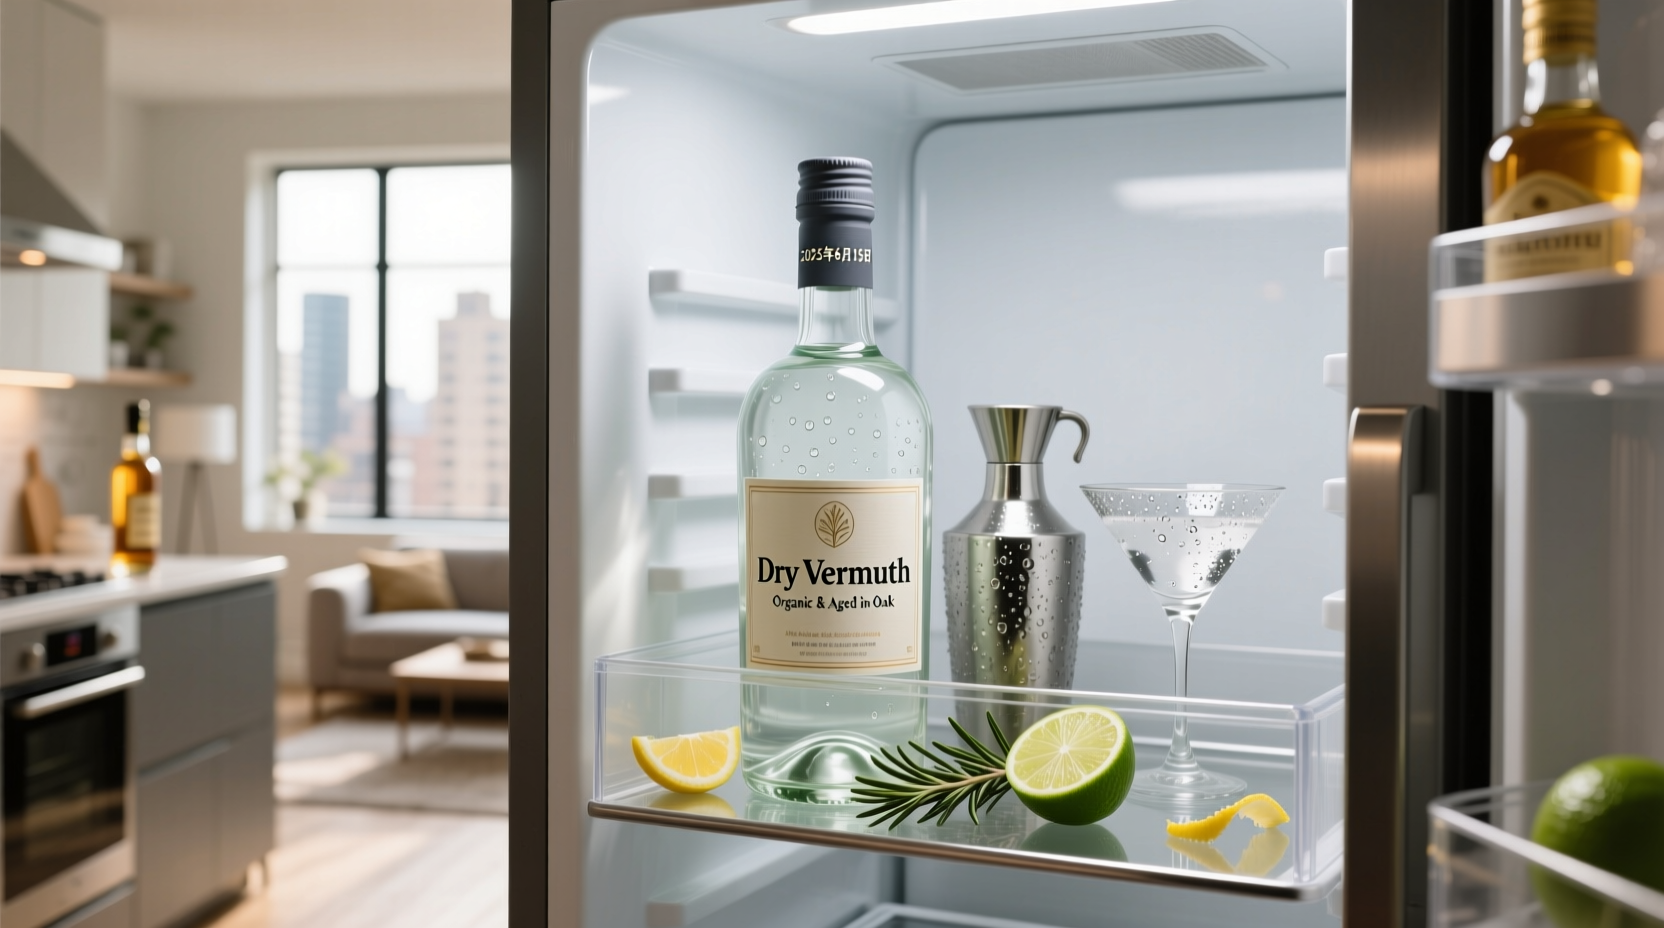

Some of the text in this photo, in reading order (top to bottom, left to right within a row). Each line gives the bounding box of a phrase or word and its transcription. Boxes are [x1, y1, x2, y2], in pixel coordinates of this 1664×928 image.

[757, 557, 911, 591] Dry Vermuth
[772, 594, 895, 612] Organic & Aged in Oak
